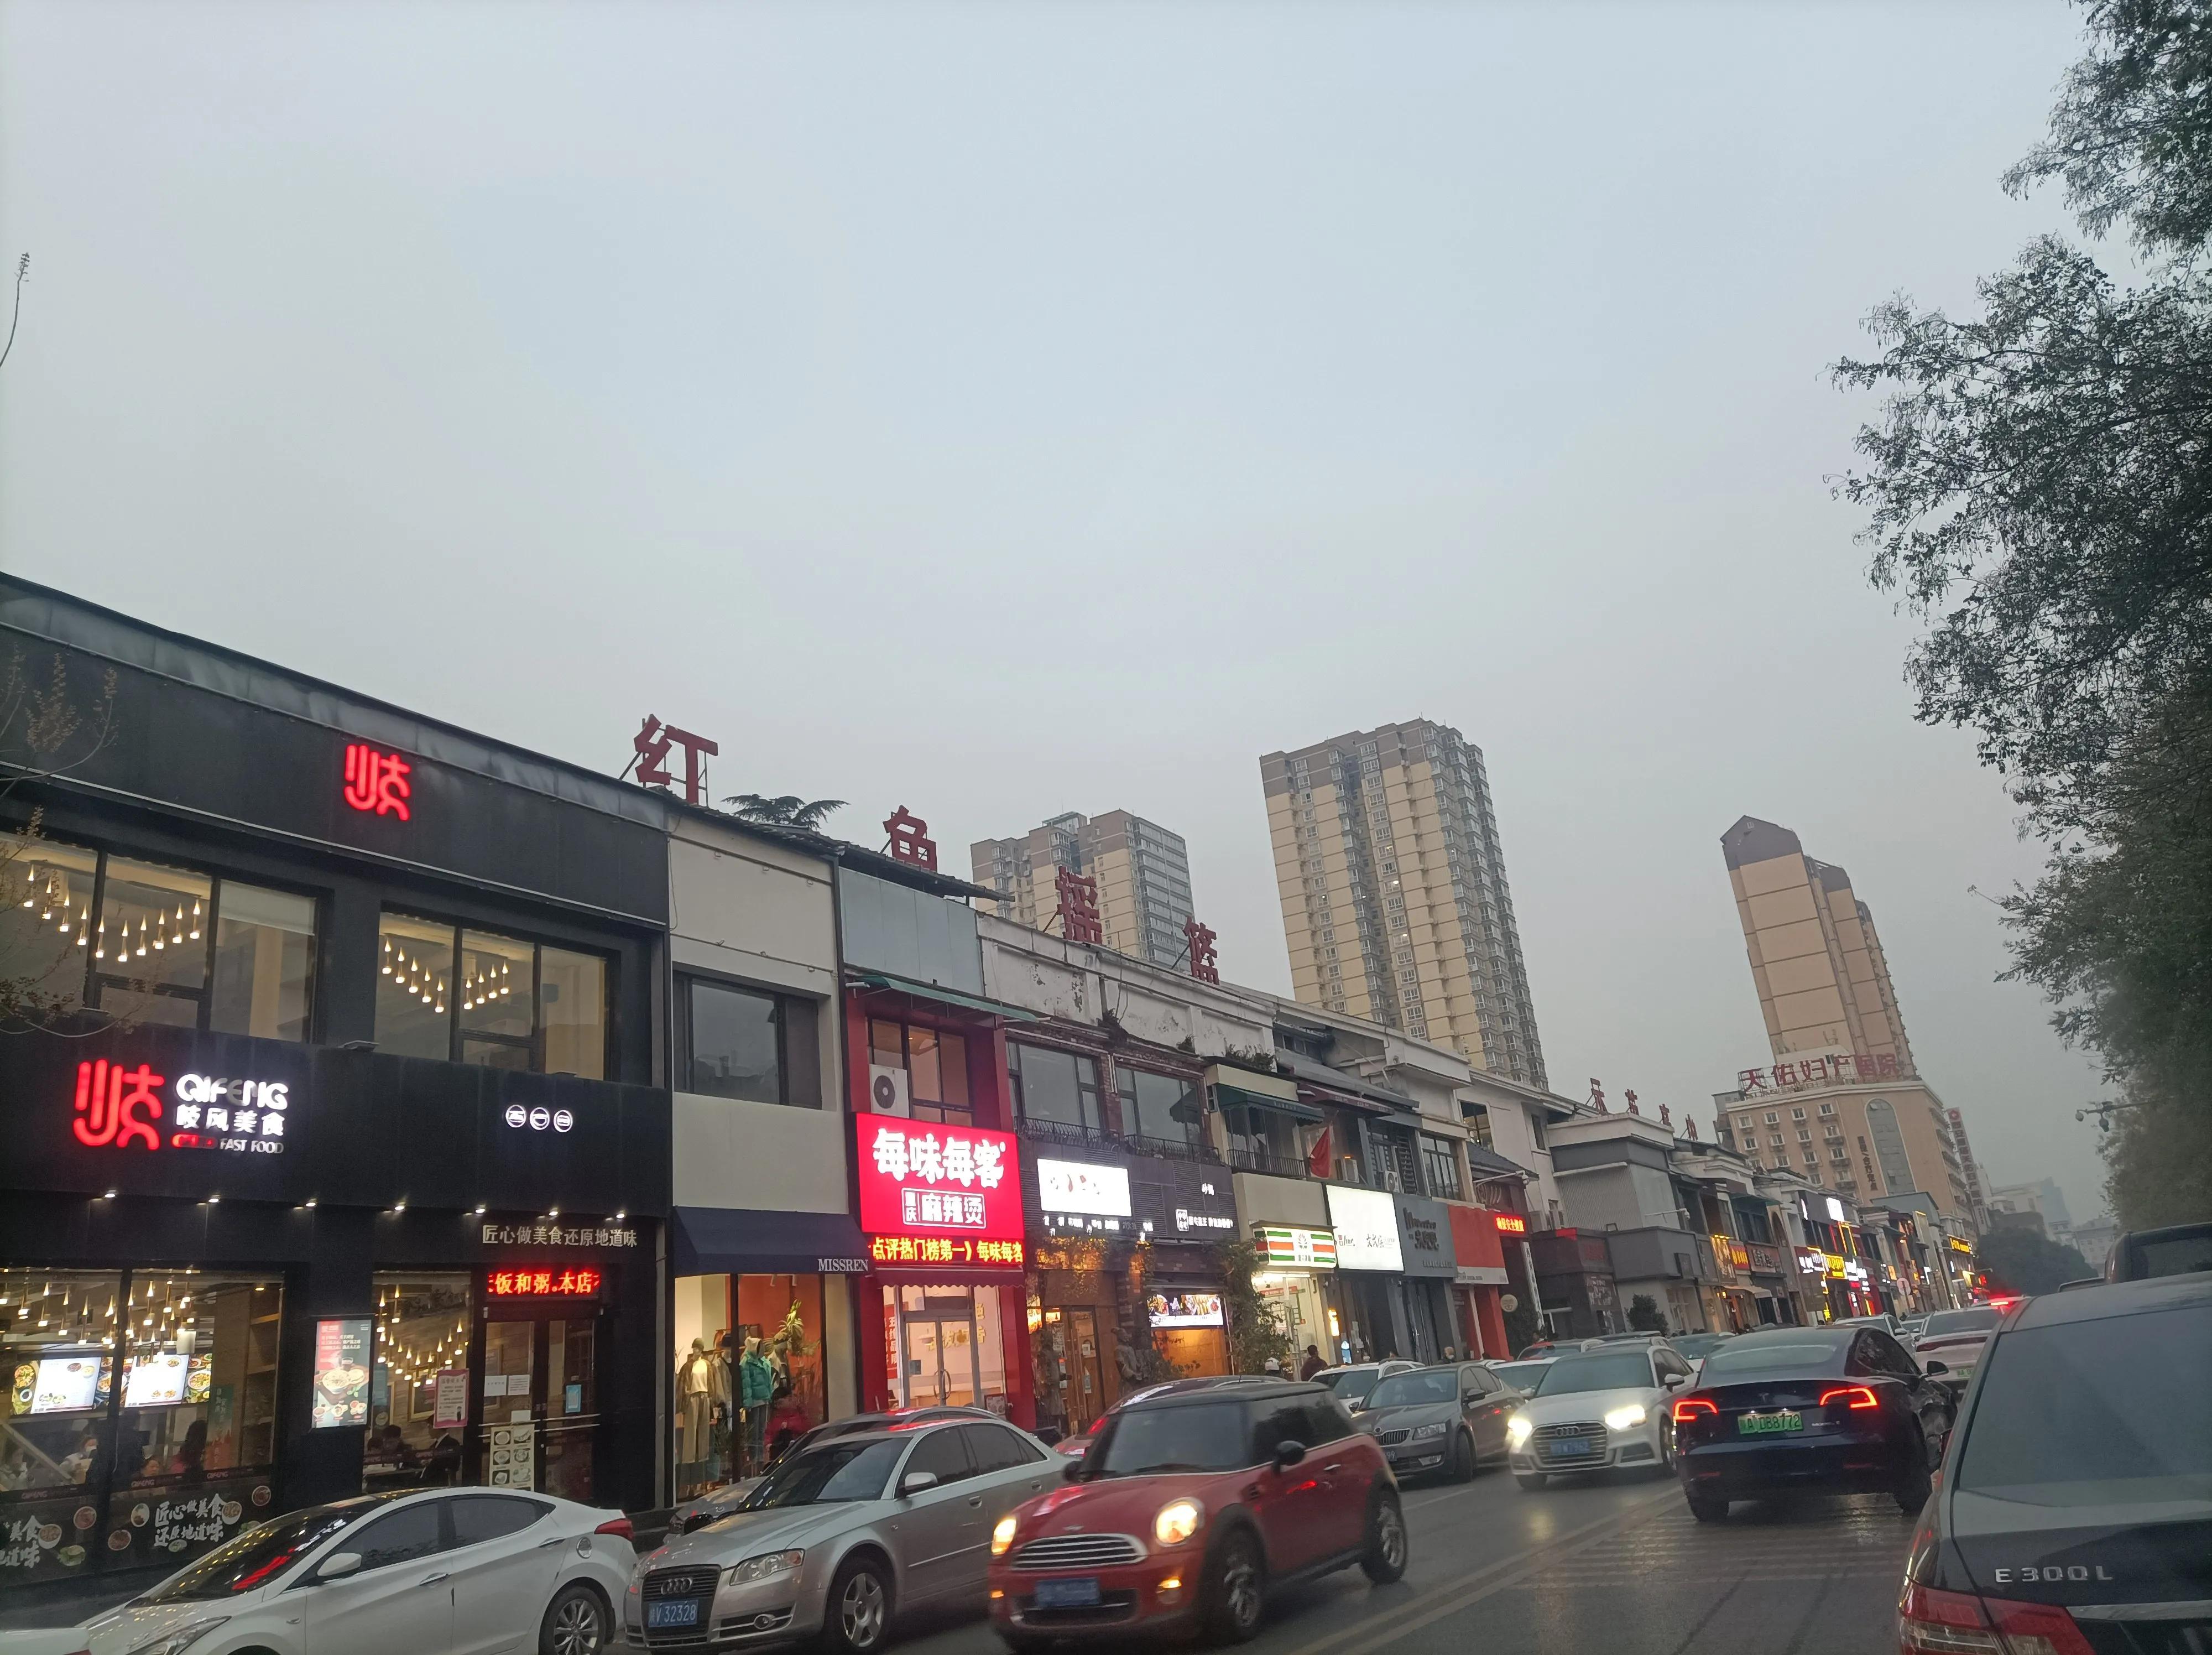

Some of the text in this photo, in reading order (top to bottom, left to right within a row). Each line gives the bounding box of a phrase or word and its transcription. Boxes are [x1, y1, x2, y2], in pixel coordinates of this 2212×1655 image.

[176, 1074, 289, 1110] QIFENG
[220, 1138, 247, 1152] FAST
[251, 1140, 284, 1154] FOOD
[872, 1128, 1005, 1189] 每味每客
[921, 1193, 984, 1224] 麻辣烫
[817, 1258, 869, 1272] MISSREN
